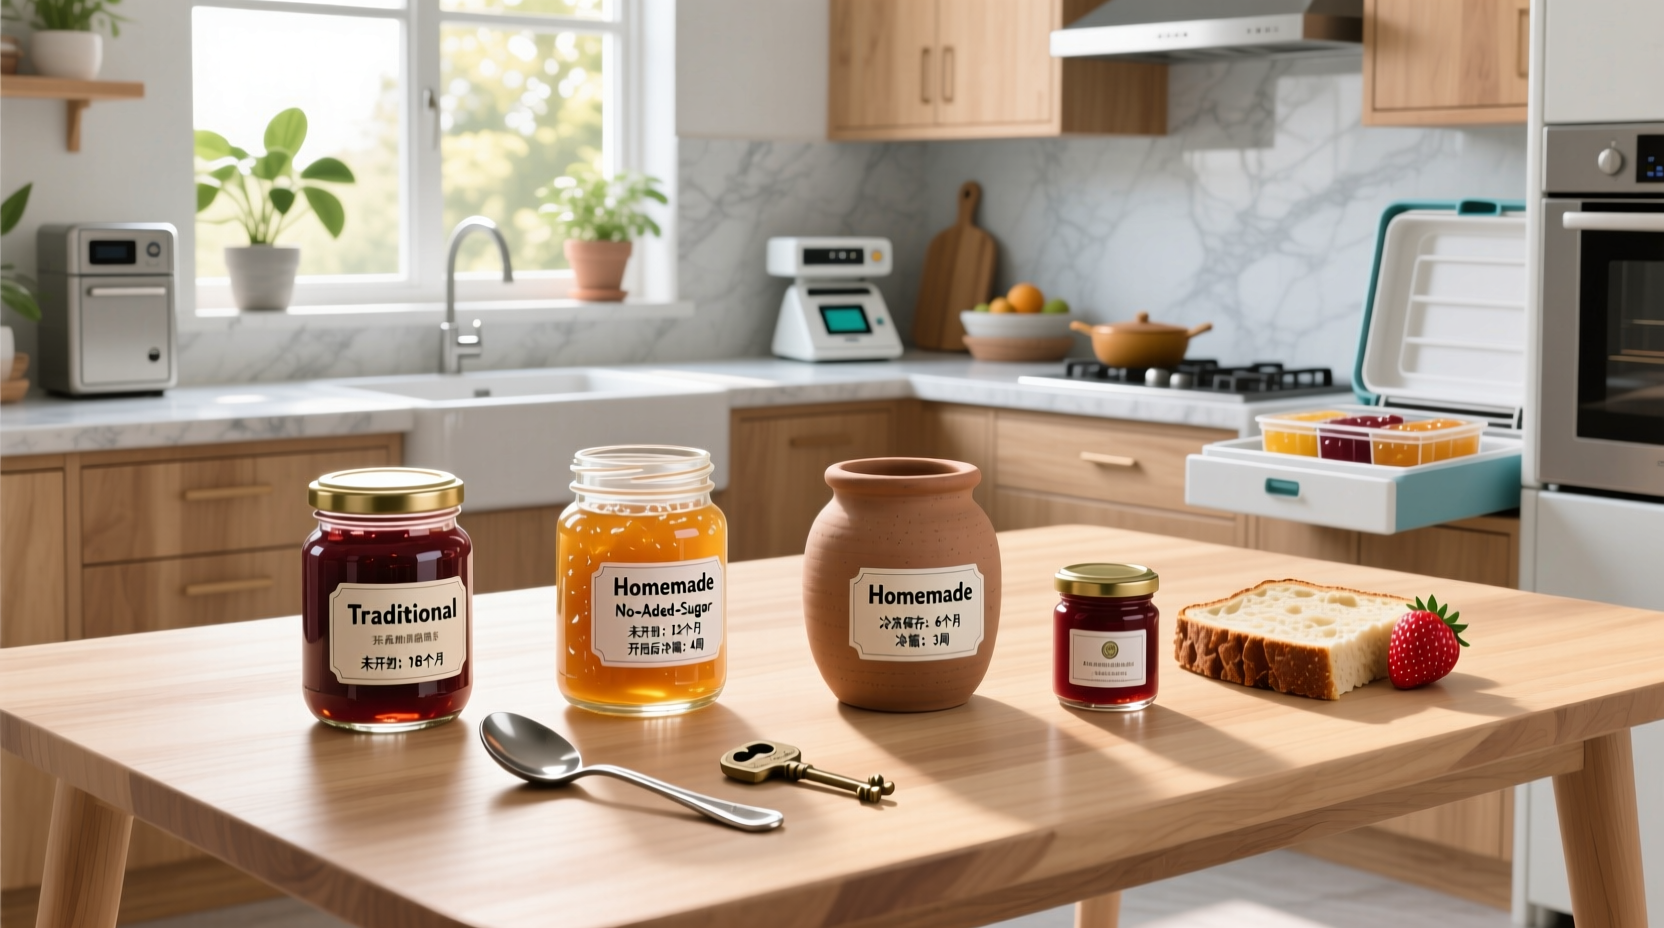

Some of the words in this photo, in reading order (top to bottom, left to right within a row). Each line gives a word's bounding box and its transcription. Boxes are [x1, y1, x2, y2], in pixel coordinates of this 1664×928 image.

[614, 572, 714, 596] Homemade
[868, 581, 973, 605] Homemade
[347, 597, 456, 625] Traditional
